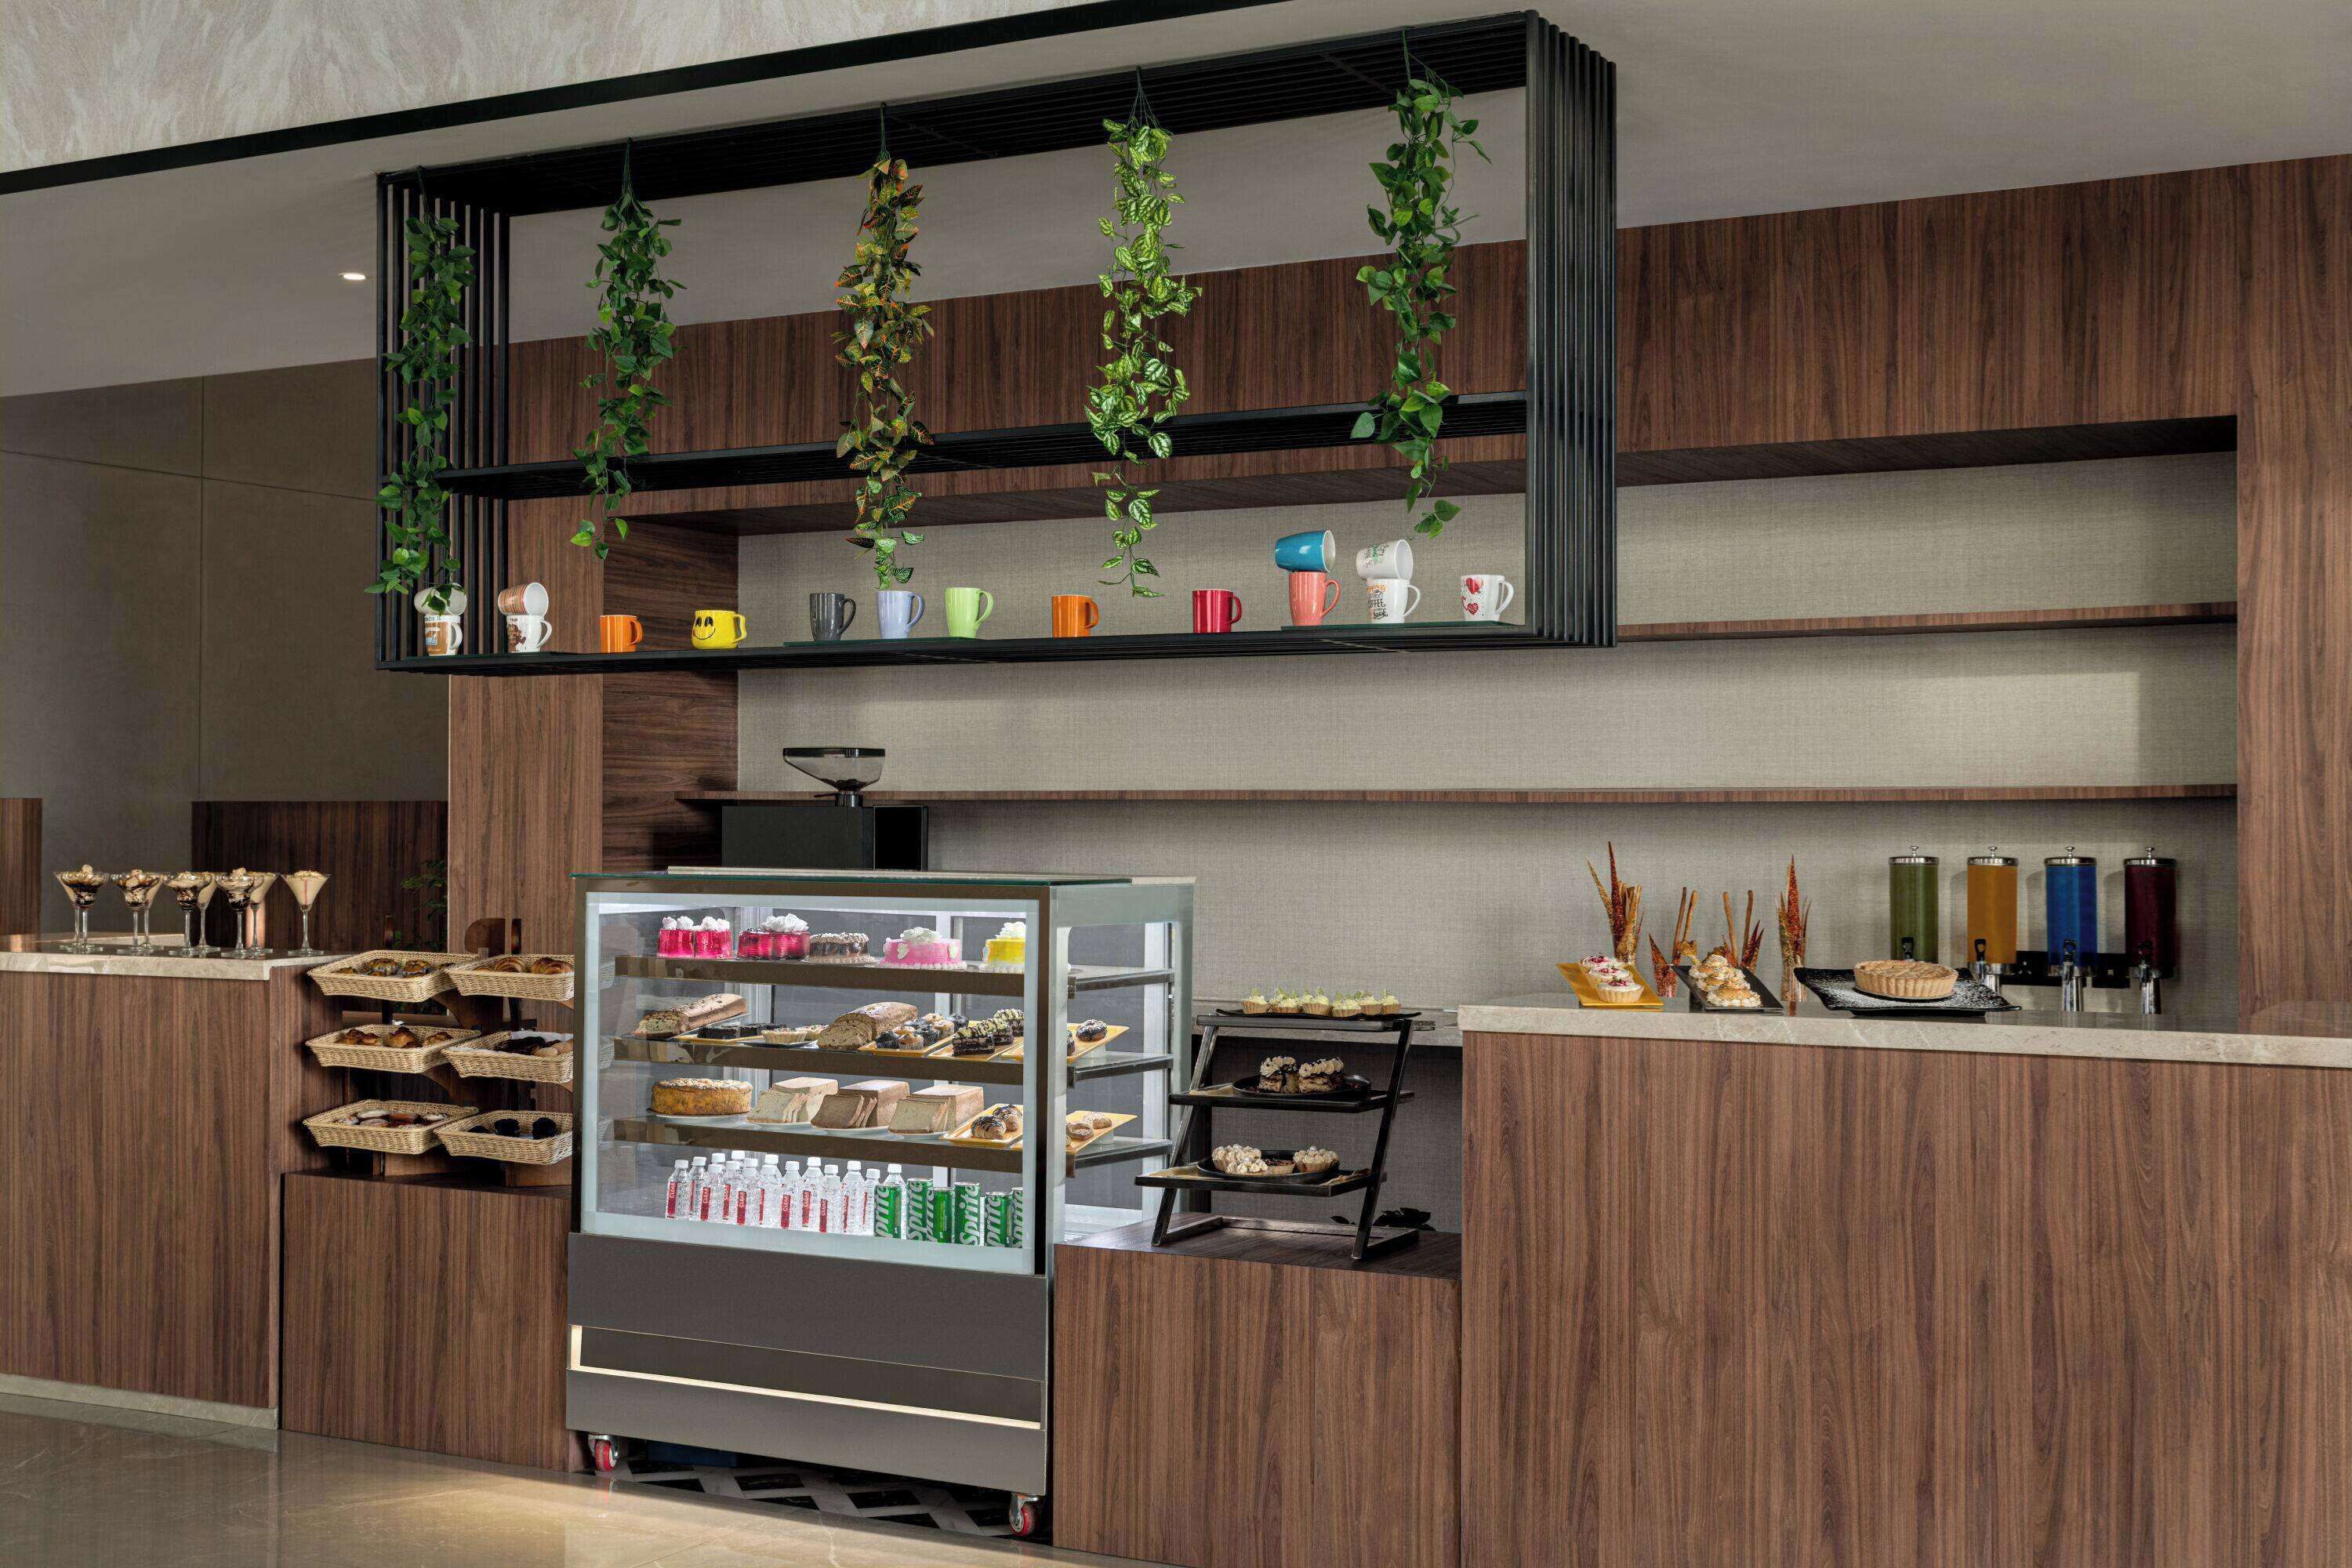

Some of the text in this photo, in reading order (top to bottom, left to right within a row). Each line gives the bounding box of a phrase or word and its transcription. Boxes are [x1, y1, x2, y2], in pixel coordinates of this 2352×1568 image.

[875, 1185, 893, 1238] prite
[960, 1185, 981, 1246] Sprite
[985, 1195, 1006, 1247] prite
